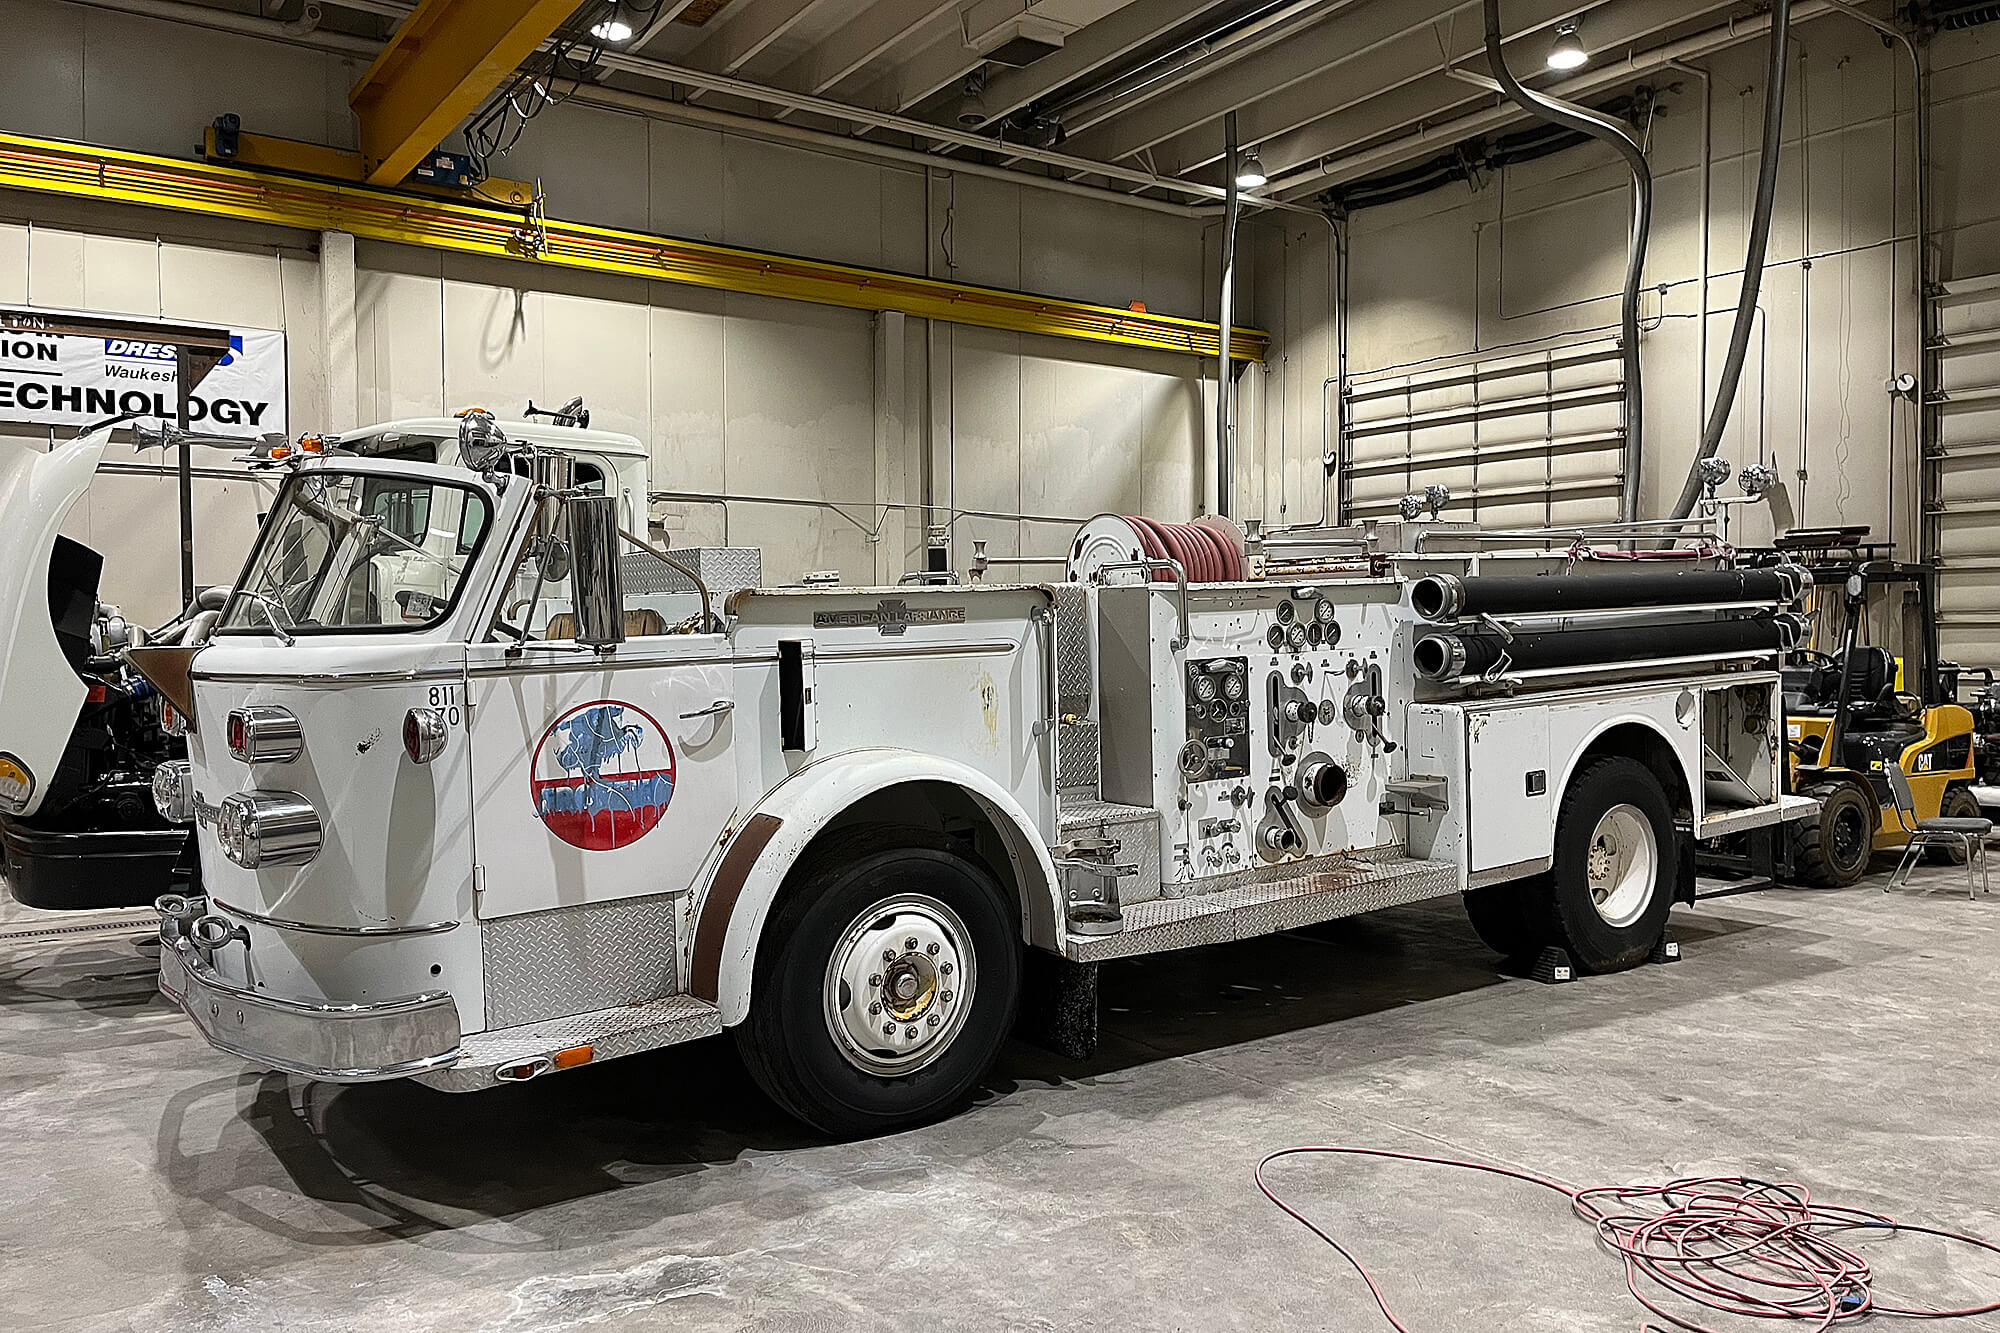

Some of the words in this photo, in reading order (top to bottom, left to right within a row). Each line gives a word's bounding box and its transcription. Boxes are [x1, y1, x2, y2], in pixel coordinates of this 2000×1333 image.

[815, 611, 891, 625] AMERICAN
[429, 686, 455, 706] 811
[1918, 753, 1933, 771] CAT
